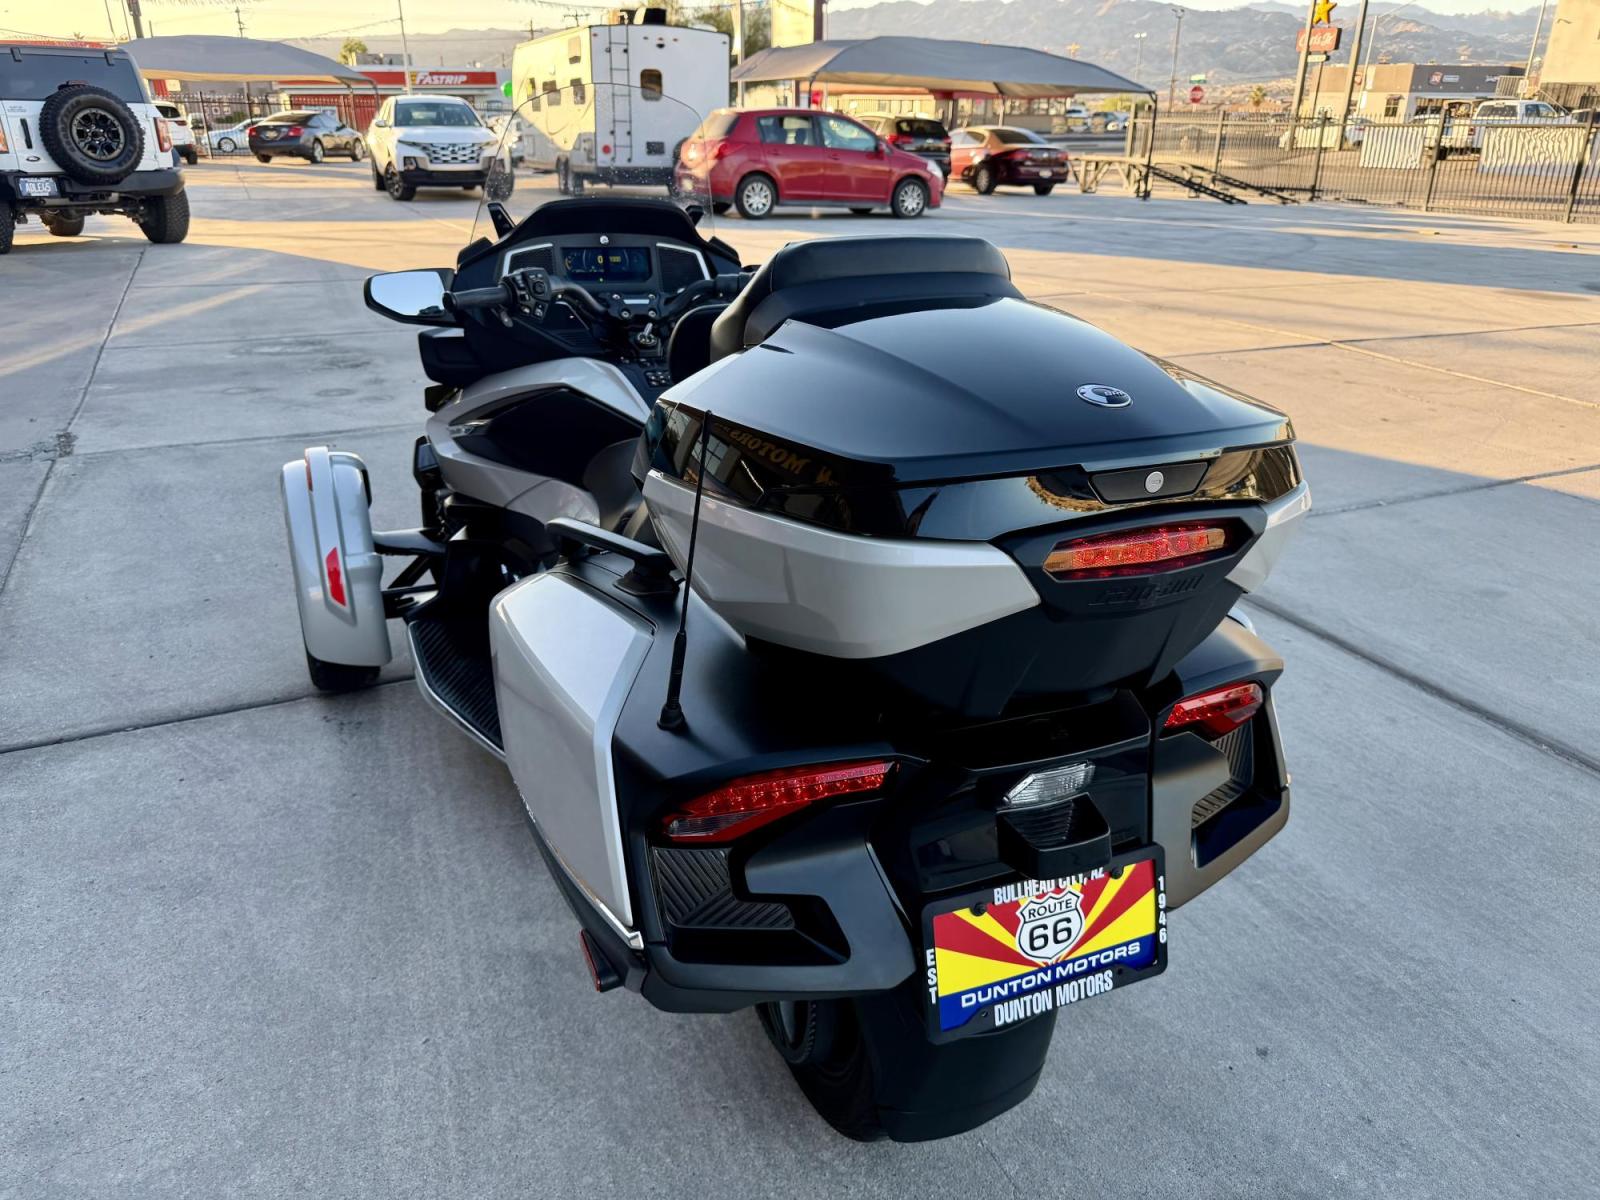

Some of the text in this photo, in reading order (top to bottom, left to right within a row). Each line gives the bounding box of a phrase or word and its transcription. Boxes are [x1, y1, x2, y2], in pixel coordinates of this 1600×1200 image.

[994, 879, 1055, 906] BULLHEAD
[1028, 898, 1073, 919] ROUTE
[1158, 875, 1167, 944] 1946
[1029, 917, 1072, 951] 66
[926, 949, 937, 1005] EST
[961, 941, 1141, 1008] DUNTON MOTORS
[994, 970, 1114, 1027] DUNTON MOTORS
